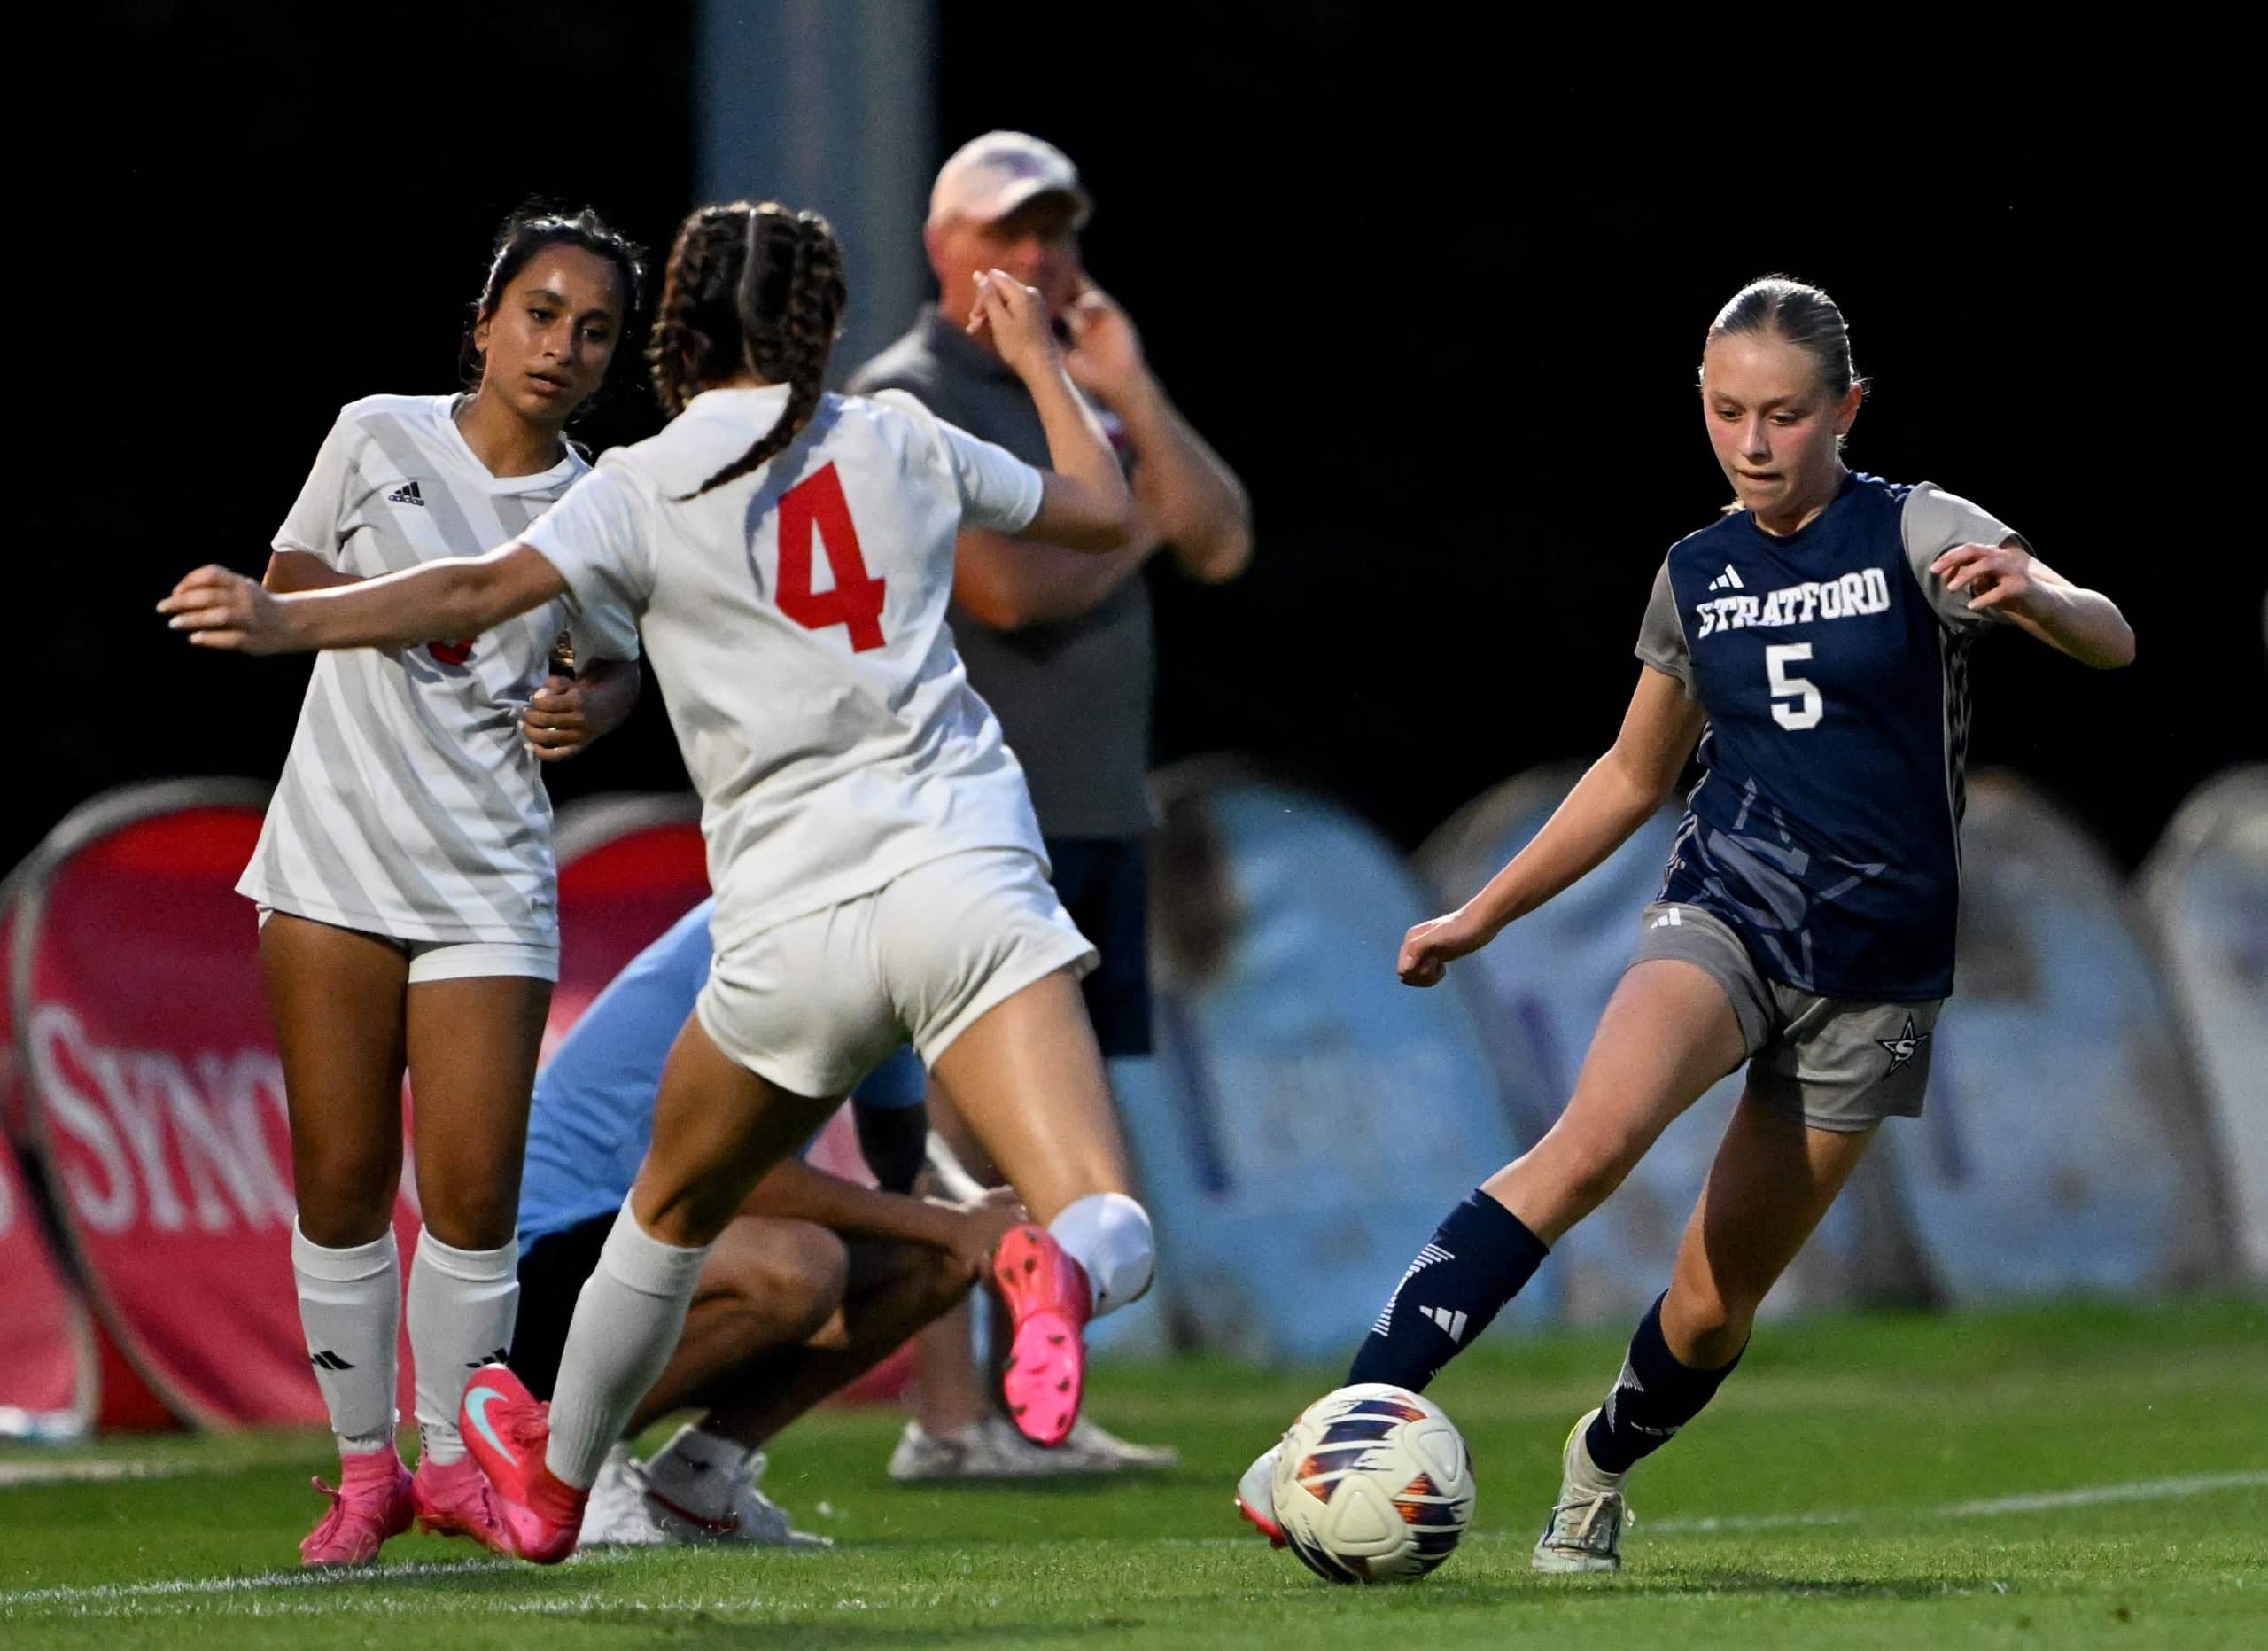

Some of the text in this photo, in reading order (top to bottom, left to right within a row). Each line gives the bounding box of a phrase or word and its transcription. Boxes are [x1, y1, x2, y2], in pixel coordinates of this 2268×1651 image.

[388, 495, 425, 507] adidas
[774, 461, 886, 653] 4
[1695, 567, 1891, 639] STRATFORD
[1765, 642, 1823, 731] 5
[1895, 1039, 1916, 1062] S
